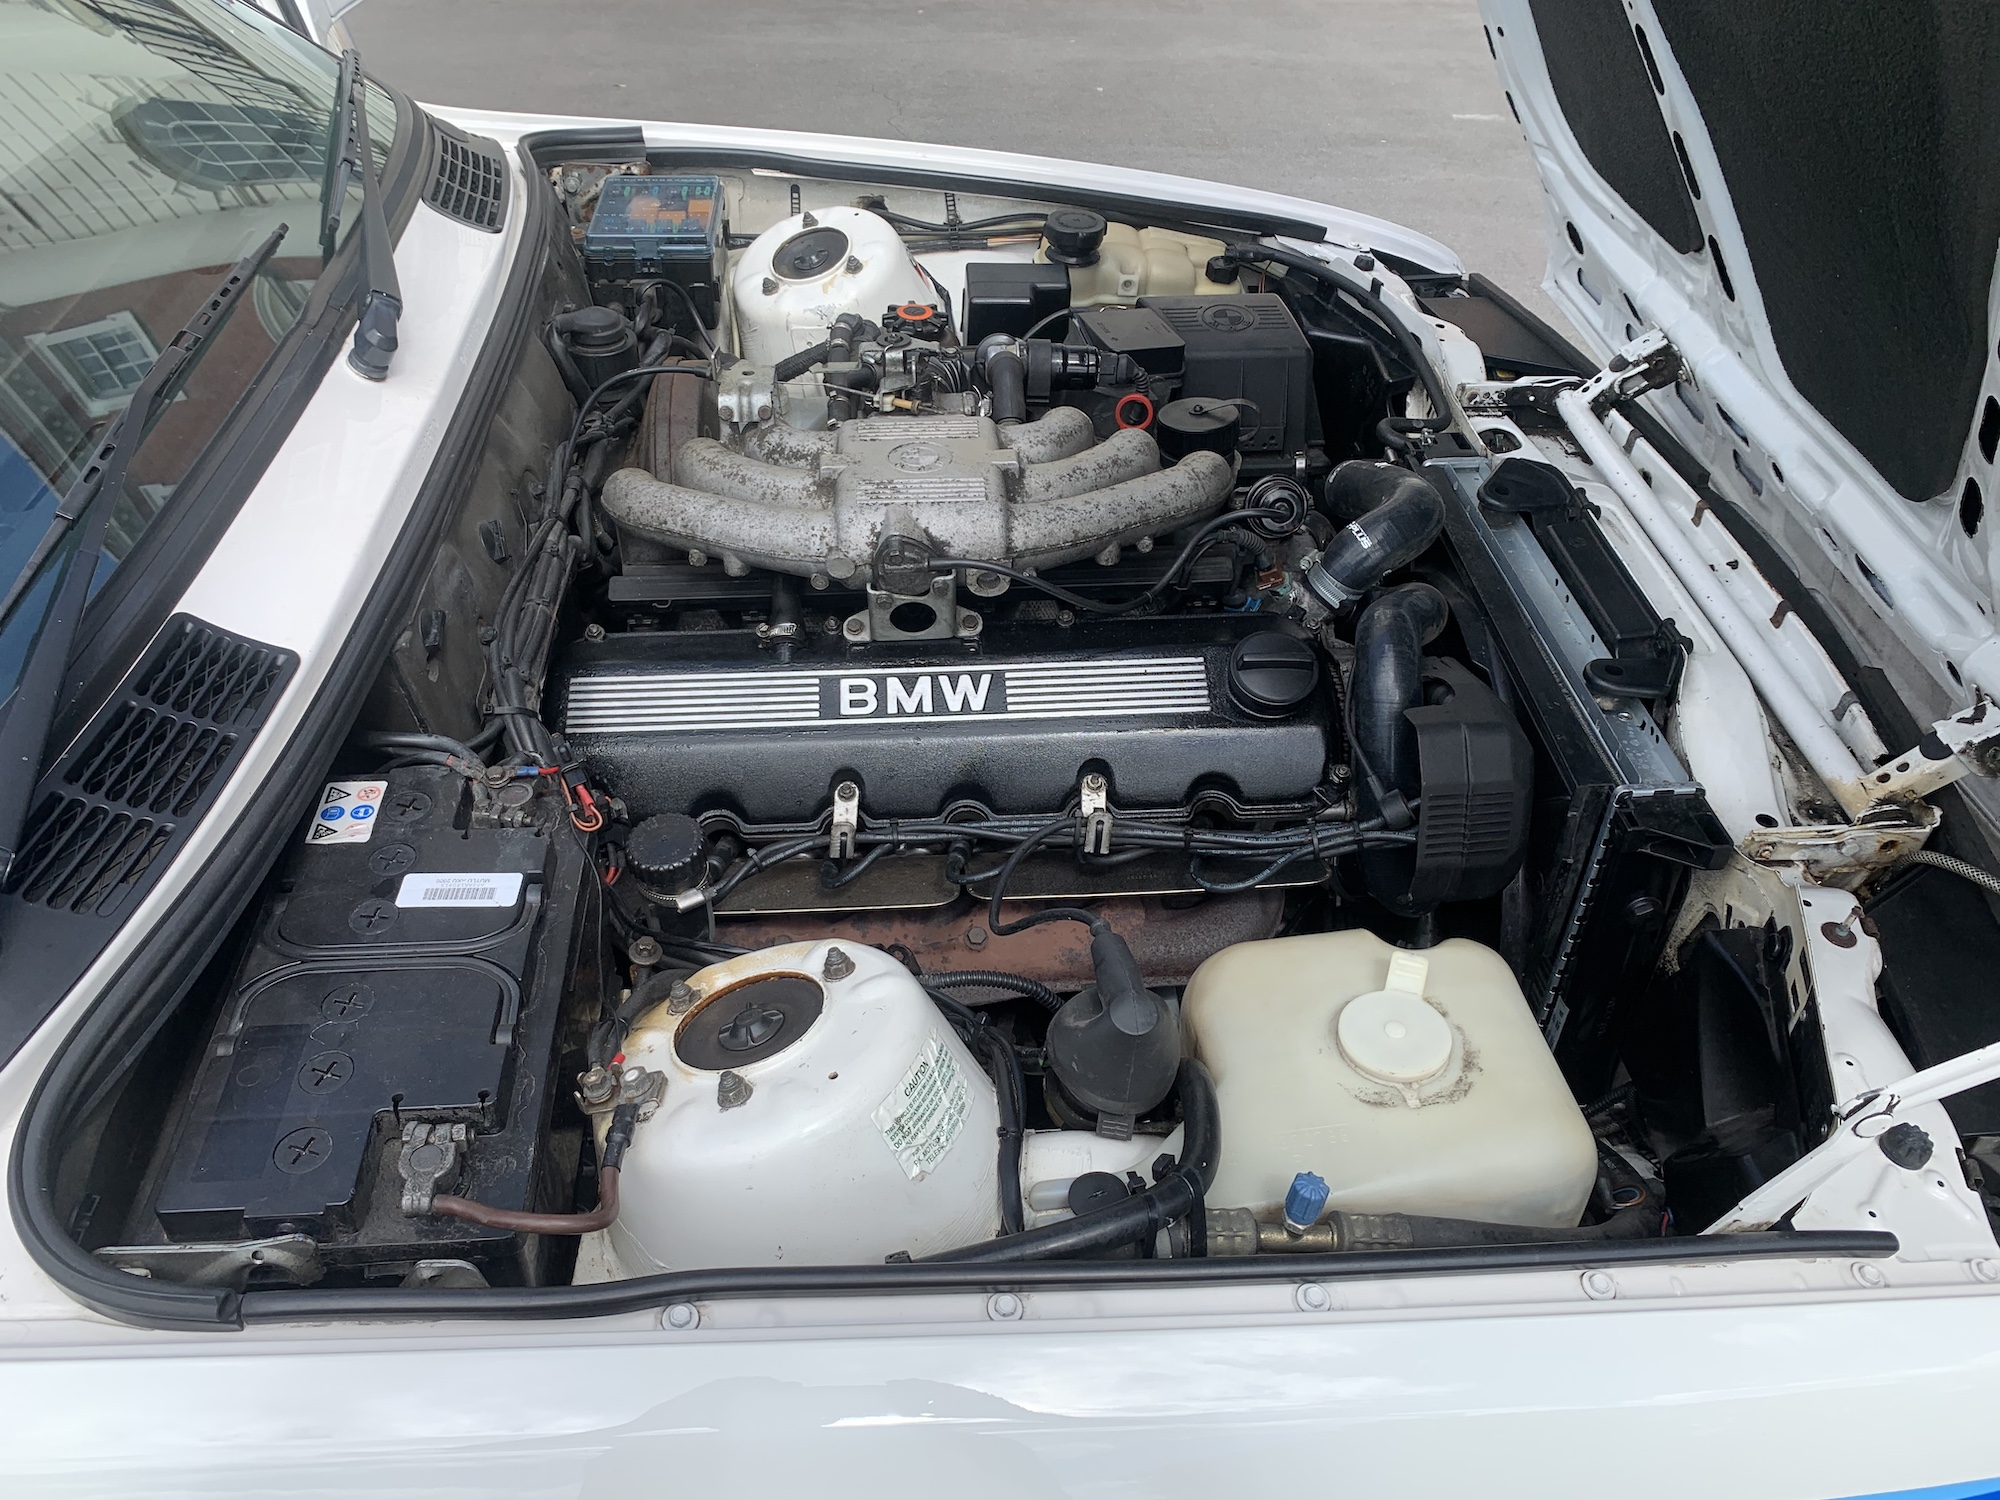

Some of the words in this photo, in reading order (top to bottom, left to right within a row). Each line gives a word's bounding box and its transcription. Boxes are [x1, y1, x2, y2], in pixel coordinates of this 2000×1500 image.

[840, 674, 992, 716] BMW
[904, 1061, 929, 1097] CAUTION
[893, 1137, 903, 1149] DO
